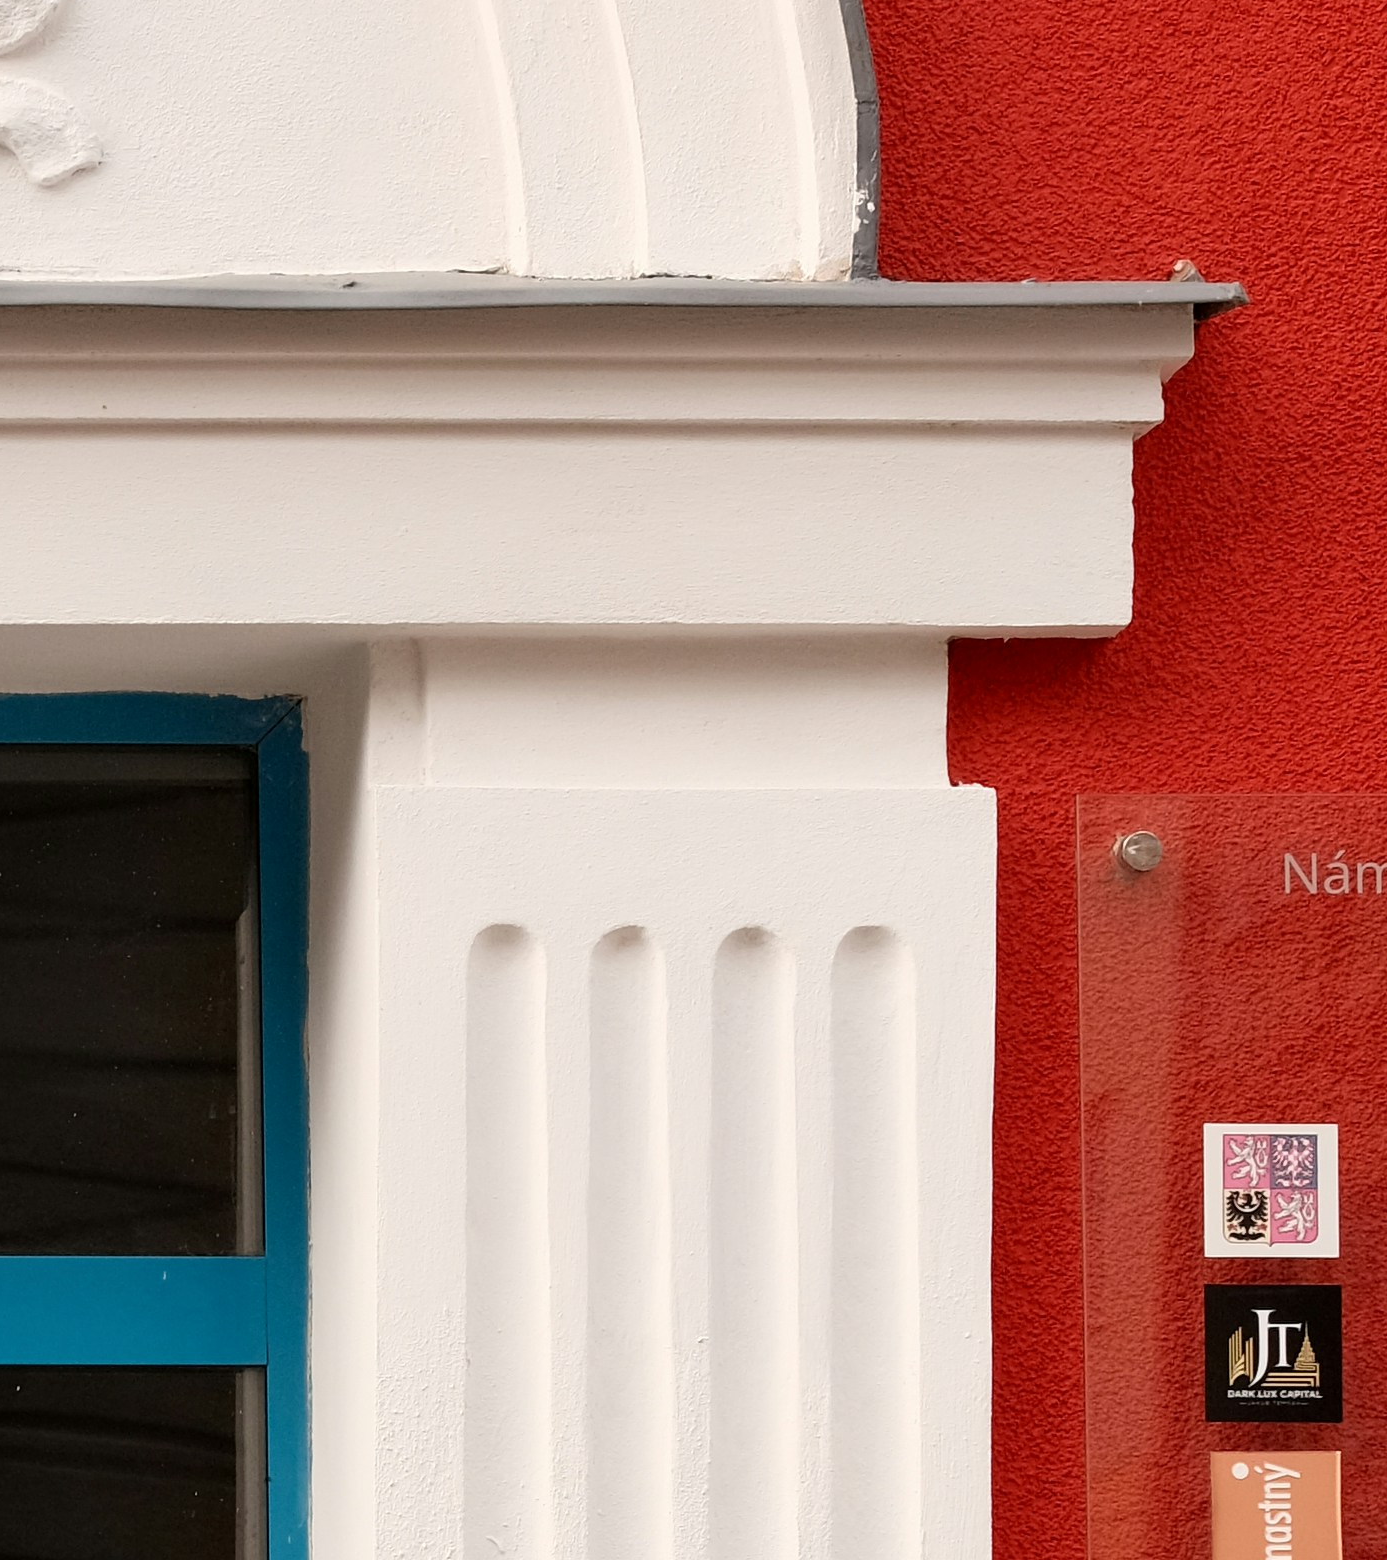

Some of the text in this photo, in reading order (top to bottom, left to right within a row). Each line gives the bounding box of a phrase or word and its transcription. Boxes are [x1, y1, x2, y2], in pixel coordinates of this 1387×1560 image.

[1227, 1389, 1323, 1399] DARK LUX CAPITAL
